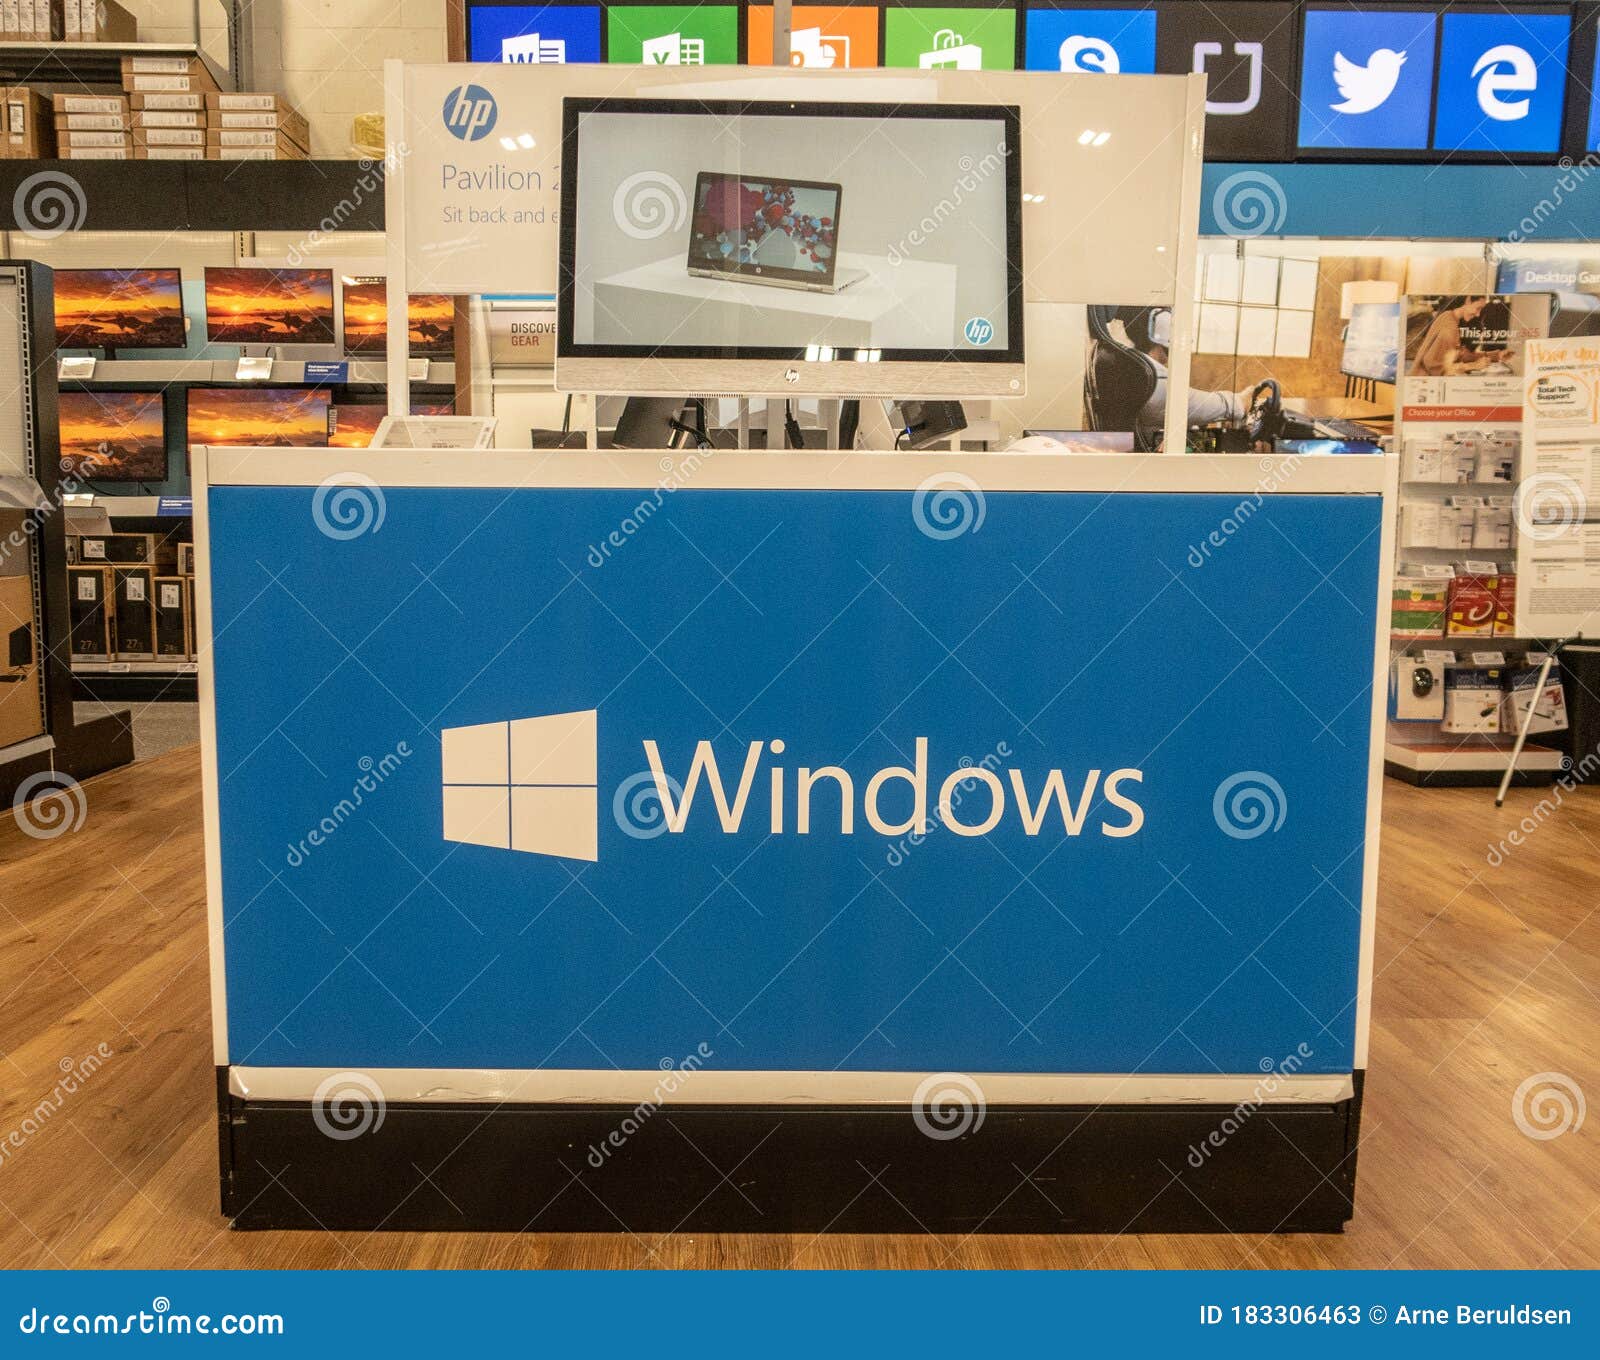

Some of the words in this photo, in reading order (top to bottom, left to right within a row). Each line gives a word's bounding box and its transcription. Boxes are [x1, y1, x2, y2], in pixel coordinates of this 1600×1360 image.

[446, 84, 496, 141] hp
[442, 164, 542, 191] Pavilion
[443, 206, 463, 223] Sit
[469, 206, 507, 223] back
[513, 206, 545, 223] and
[1525, 271, 1577, 286] Desktop
[964, 317, 993, 345] hp
[1459, 327, 1481, 338] This
[1483, 327, 1492, 338] is
[1493, 329, 1517, 340] your
[511, 335, 540, 346] GEAR
[1408, 408, 1434, 417] Choose
[643, 736, 1145, 838] Windows
